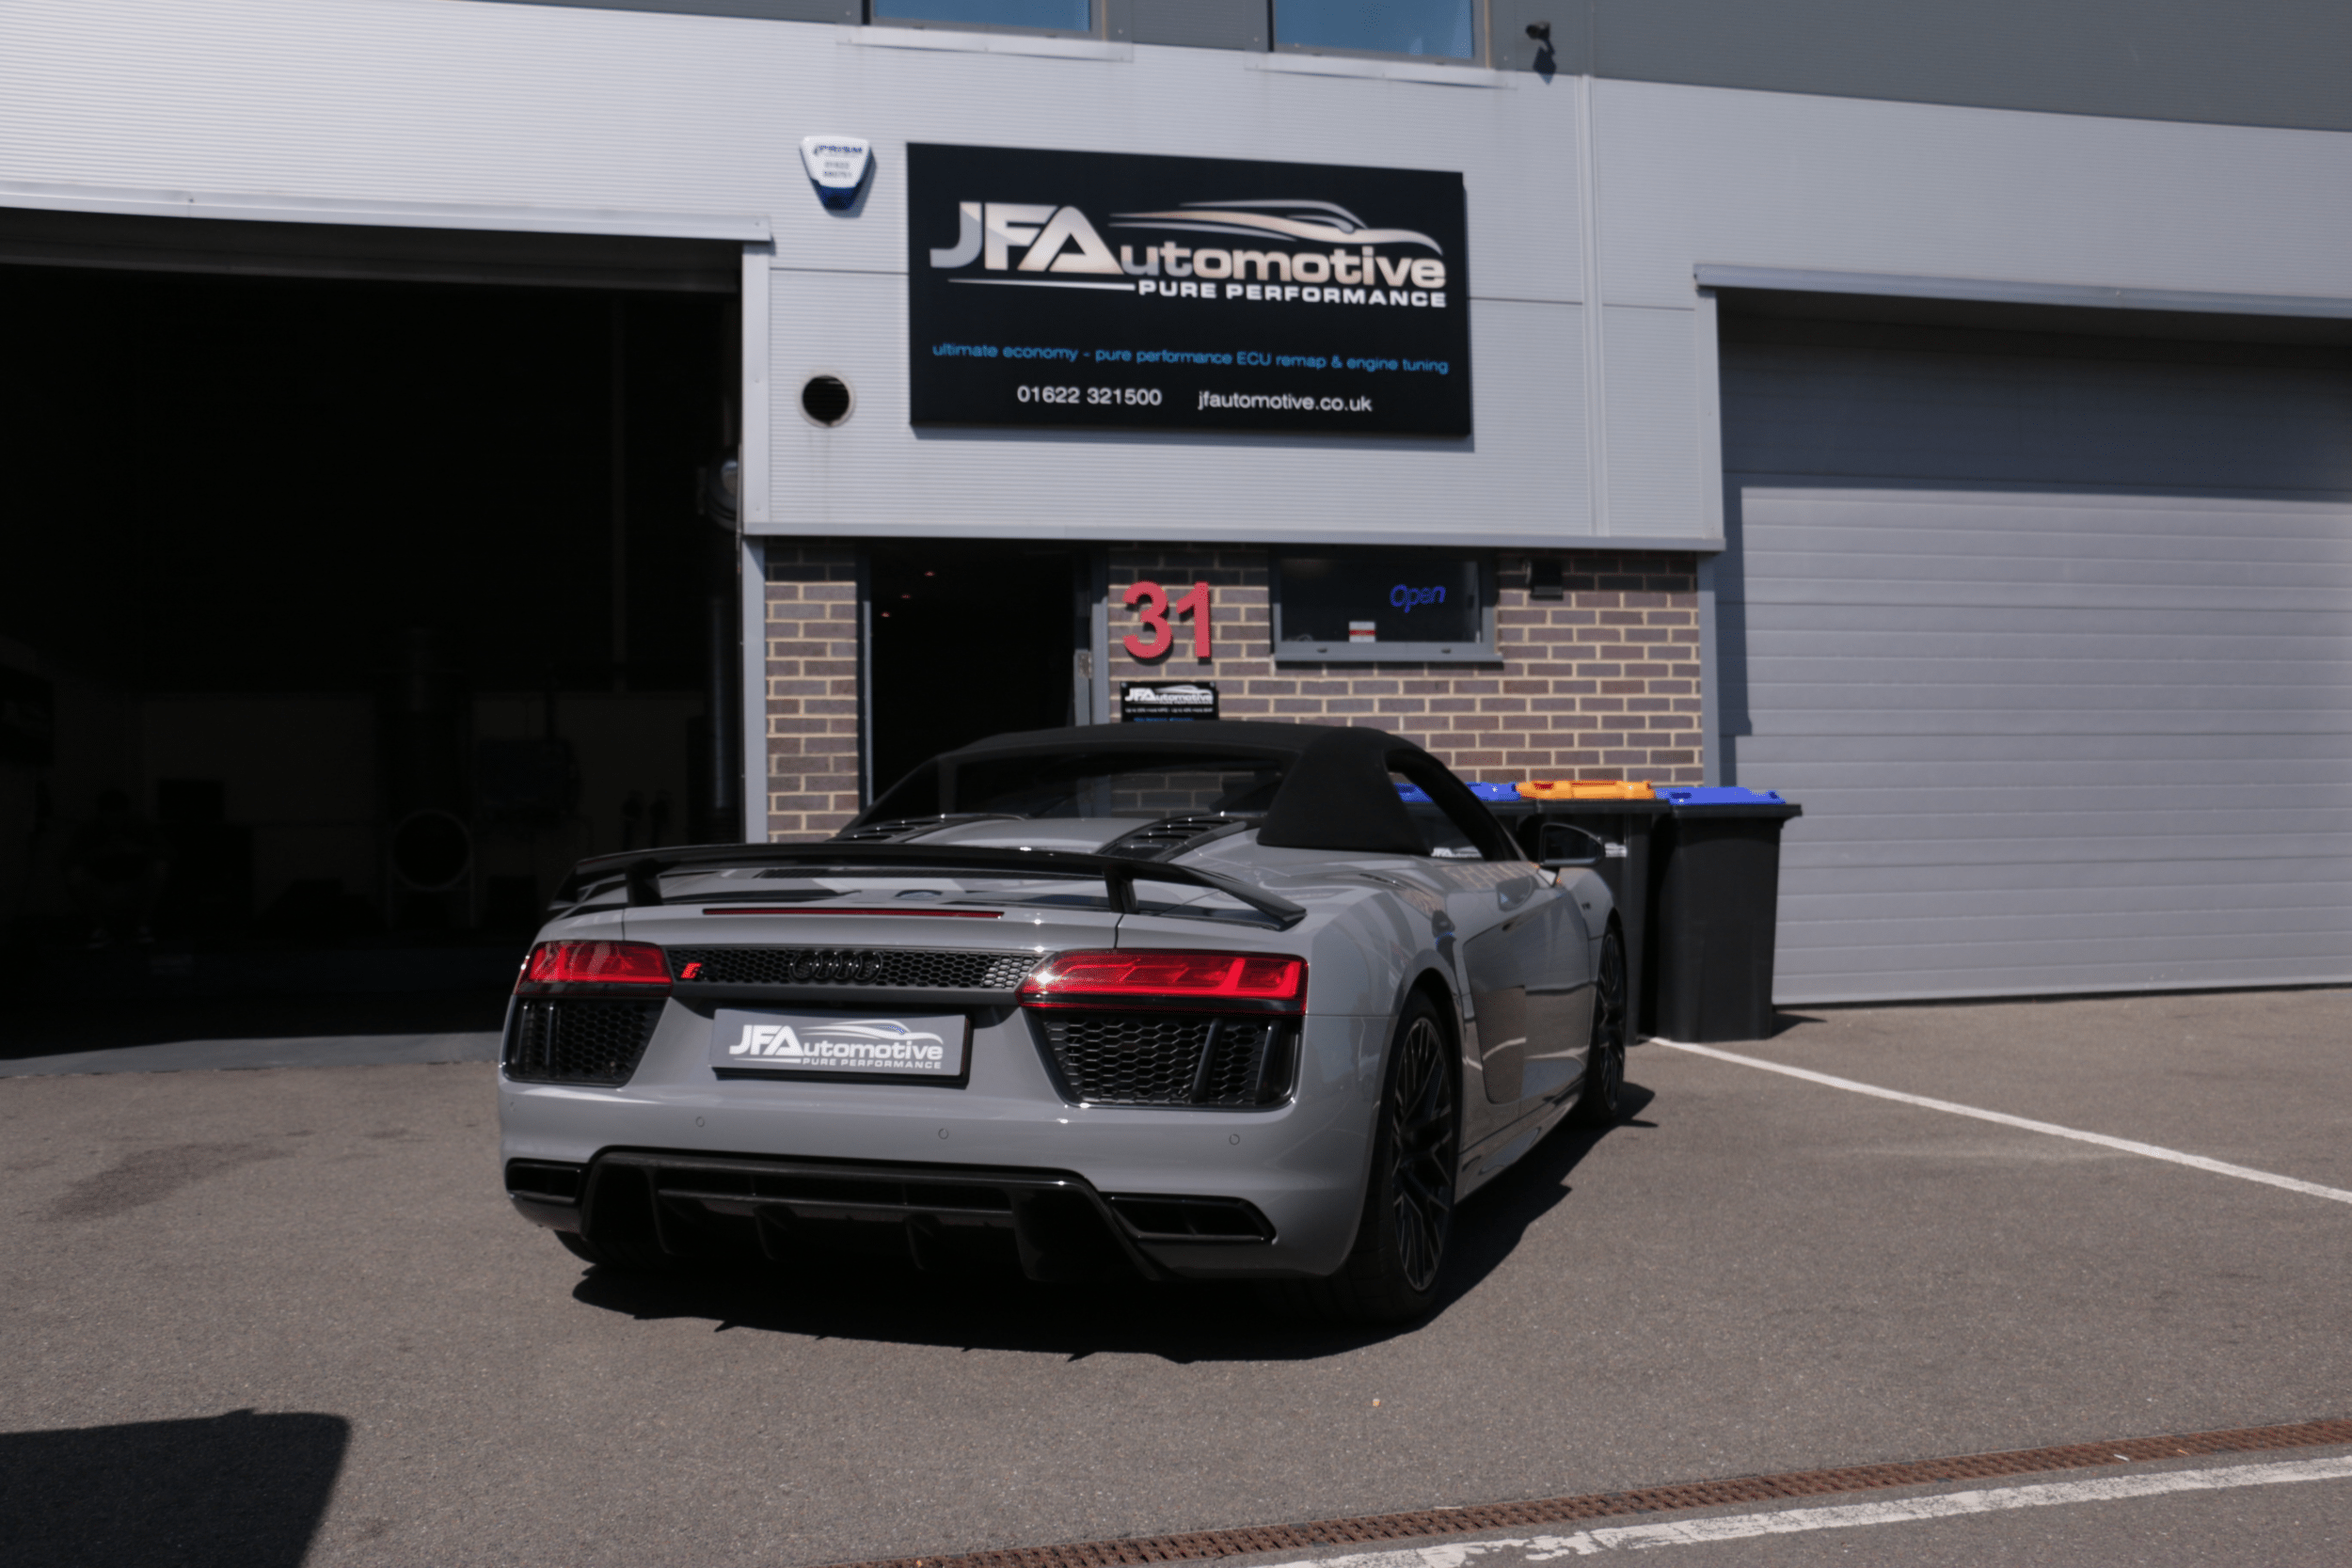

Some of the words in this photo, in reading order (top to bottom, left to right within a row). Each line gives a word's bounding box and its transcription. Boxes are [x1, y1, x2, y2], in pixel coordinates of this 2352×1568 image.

[1138, 279, 1217, 299] PURE
[1225, 283, 1447, 308] PERFORMANCE
[932, 342, 999, 358] ultimate
[1002, 345, 1079, 363] economy
[1095, 349, 1133, 363] pure
[1136, 349, 1233, 365] performance
[1236, 350, 1272, 367] ECU
[1275, 354, 1327, 370] remap
[1330, 355, 1343, 369] &
[1345, 357, 1399, 373] engine
[1402, 358, 1450, 375] tuning
[1017, 386, 1080, 404] 01622
[1087, 387, 1163, 405] 321500
[1198, 390, 1373, 412] jfautomotive.co.uk
[1390, 583, 1446, 613] Open
[1122, 580, 1212, 658] 31
[803, 1057, 836, 1067] PURE
[840, 1058, 942, 1069] PERFORMANCE
